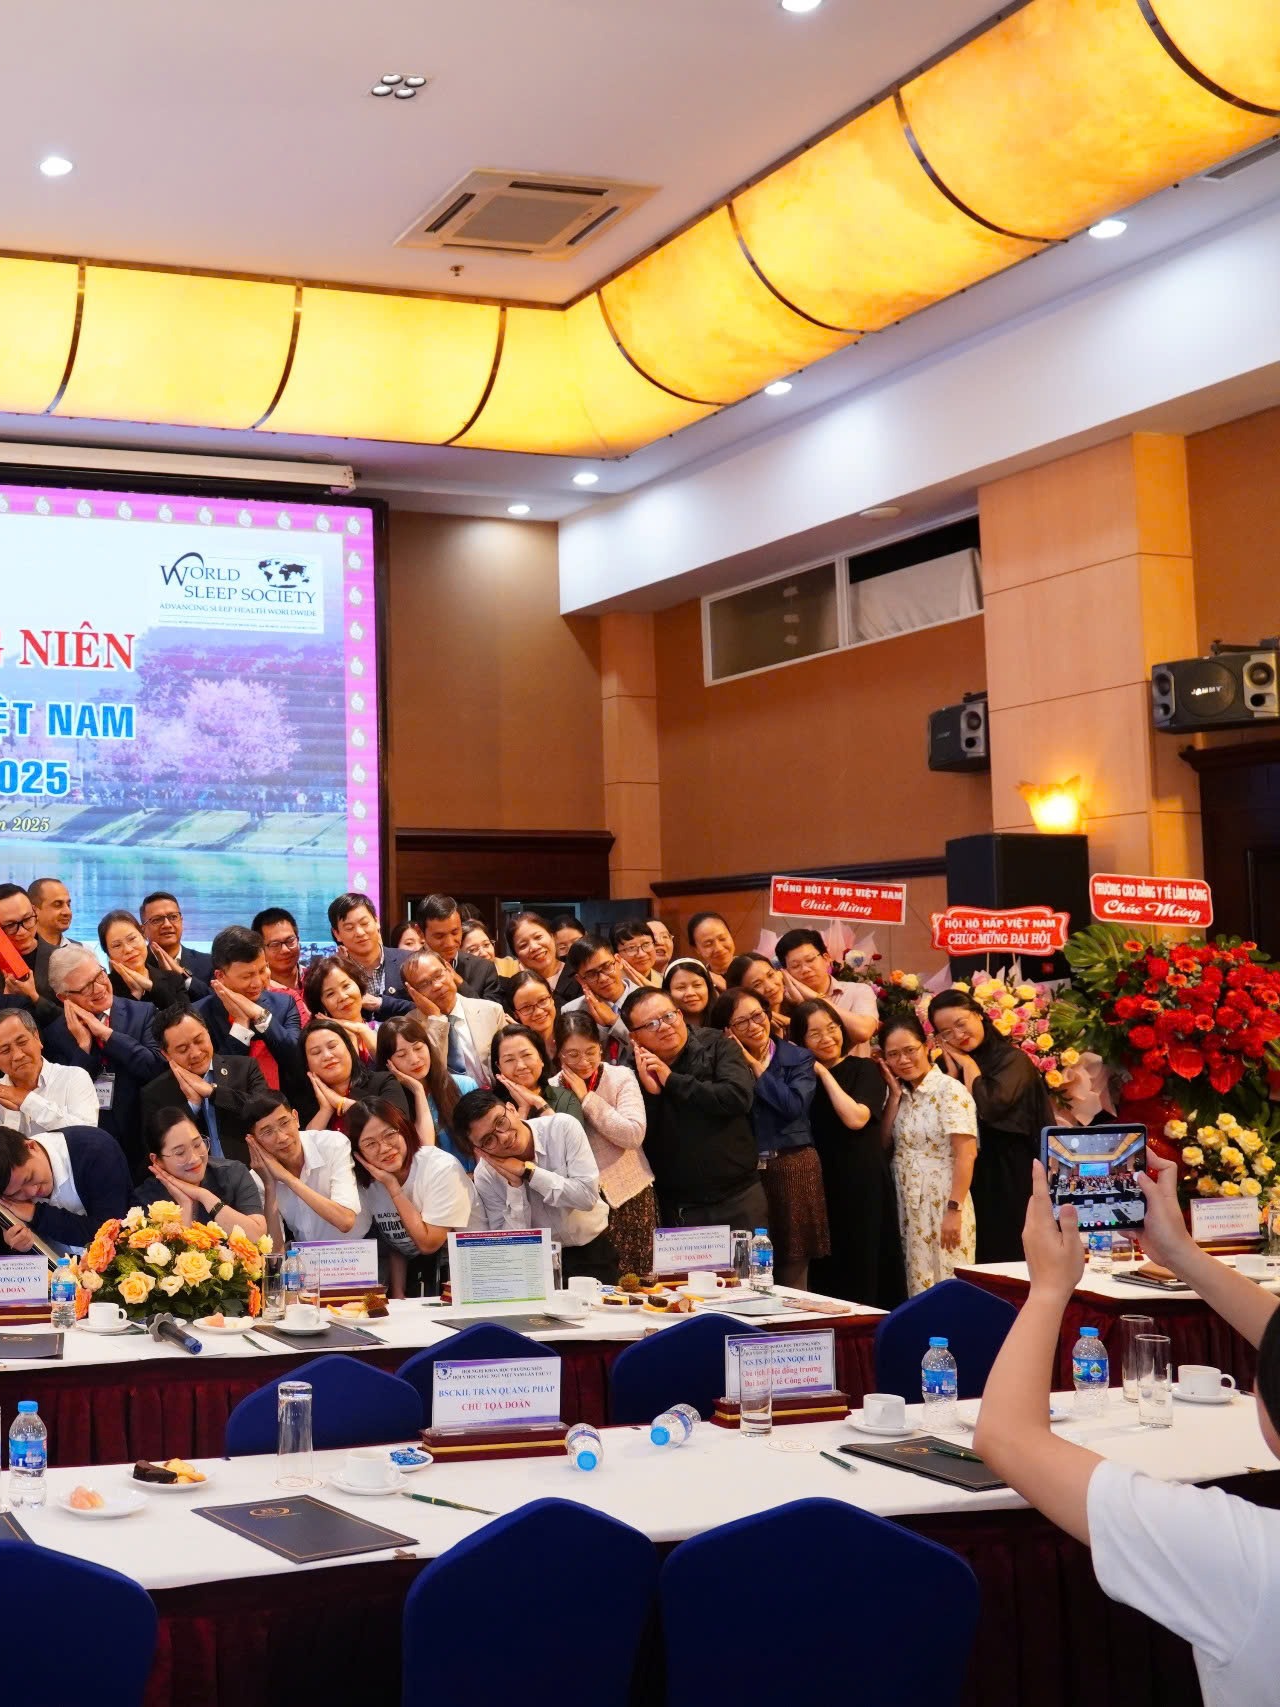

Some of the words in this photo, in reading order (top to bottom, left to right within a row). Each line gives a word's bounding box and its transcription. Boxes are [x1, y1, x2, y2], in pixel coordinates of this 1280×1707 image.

[160, 552, 240, 586] WORLD
[184, 585, 237, 600] SLEEP
[241, 588, 317, 604] SOCIETY
[160, 603, 209, 612] ADVANCING
[210, 605, 233, 613] SLEEP
[234, 607, 266, 615] HEALTH
[267, 608, 317, 617] WORLDWIDE
[19, 620, 135, 669] NIÊN
[49, 704, 134, 738] NAM
[12, 817, 51, 833] 2025
[776, 881, 802, 893] TỔNG
[805, 885, 821, 894] HỘI
[824, 886, 831, 895] Y
[833, 887, 853, 897] HỌC
[855, 887, 879, 899] VIỆT
[881, 890, 903, 900] NAM
[1157, 886, 1163, 899] Y
[800, 898, 832, 911] Chúc
[832, 901, 872, 916] Mừng
[1103, 899, 1143, 914] Chúc
[1145, 902, 1201, 924] Mừng
[945, 918, 963, 929] HỘI
[965, 919, 980, 928] HÔ
[983, 917, 1004, 928] HẤP
[1006, 918, 1029, 929] VIỆT
[1032, 919, 1056, 928] NAM
[947, 931, 977, 945] CHÚC
[978, 930, 1008, 945] MỪNG
[1010, 932, 1029, 947] ĐẠI
[1031, 930, 1051, 947] HỘI
[787, 1356, 805, 1364] NGỌC
[784, 1376, 801, 1385] Công
[473, 1387, 496, 1396] TRẦN
[498, 1386, 530, 1396] QUANG
[461, 1400, 482, 1411] CHỦ
[485, 1401, 502, 1412] TỌA
[505, 1399, 531, 1409] ĐOÀN
